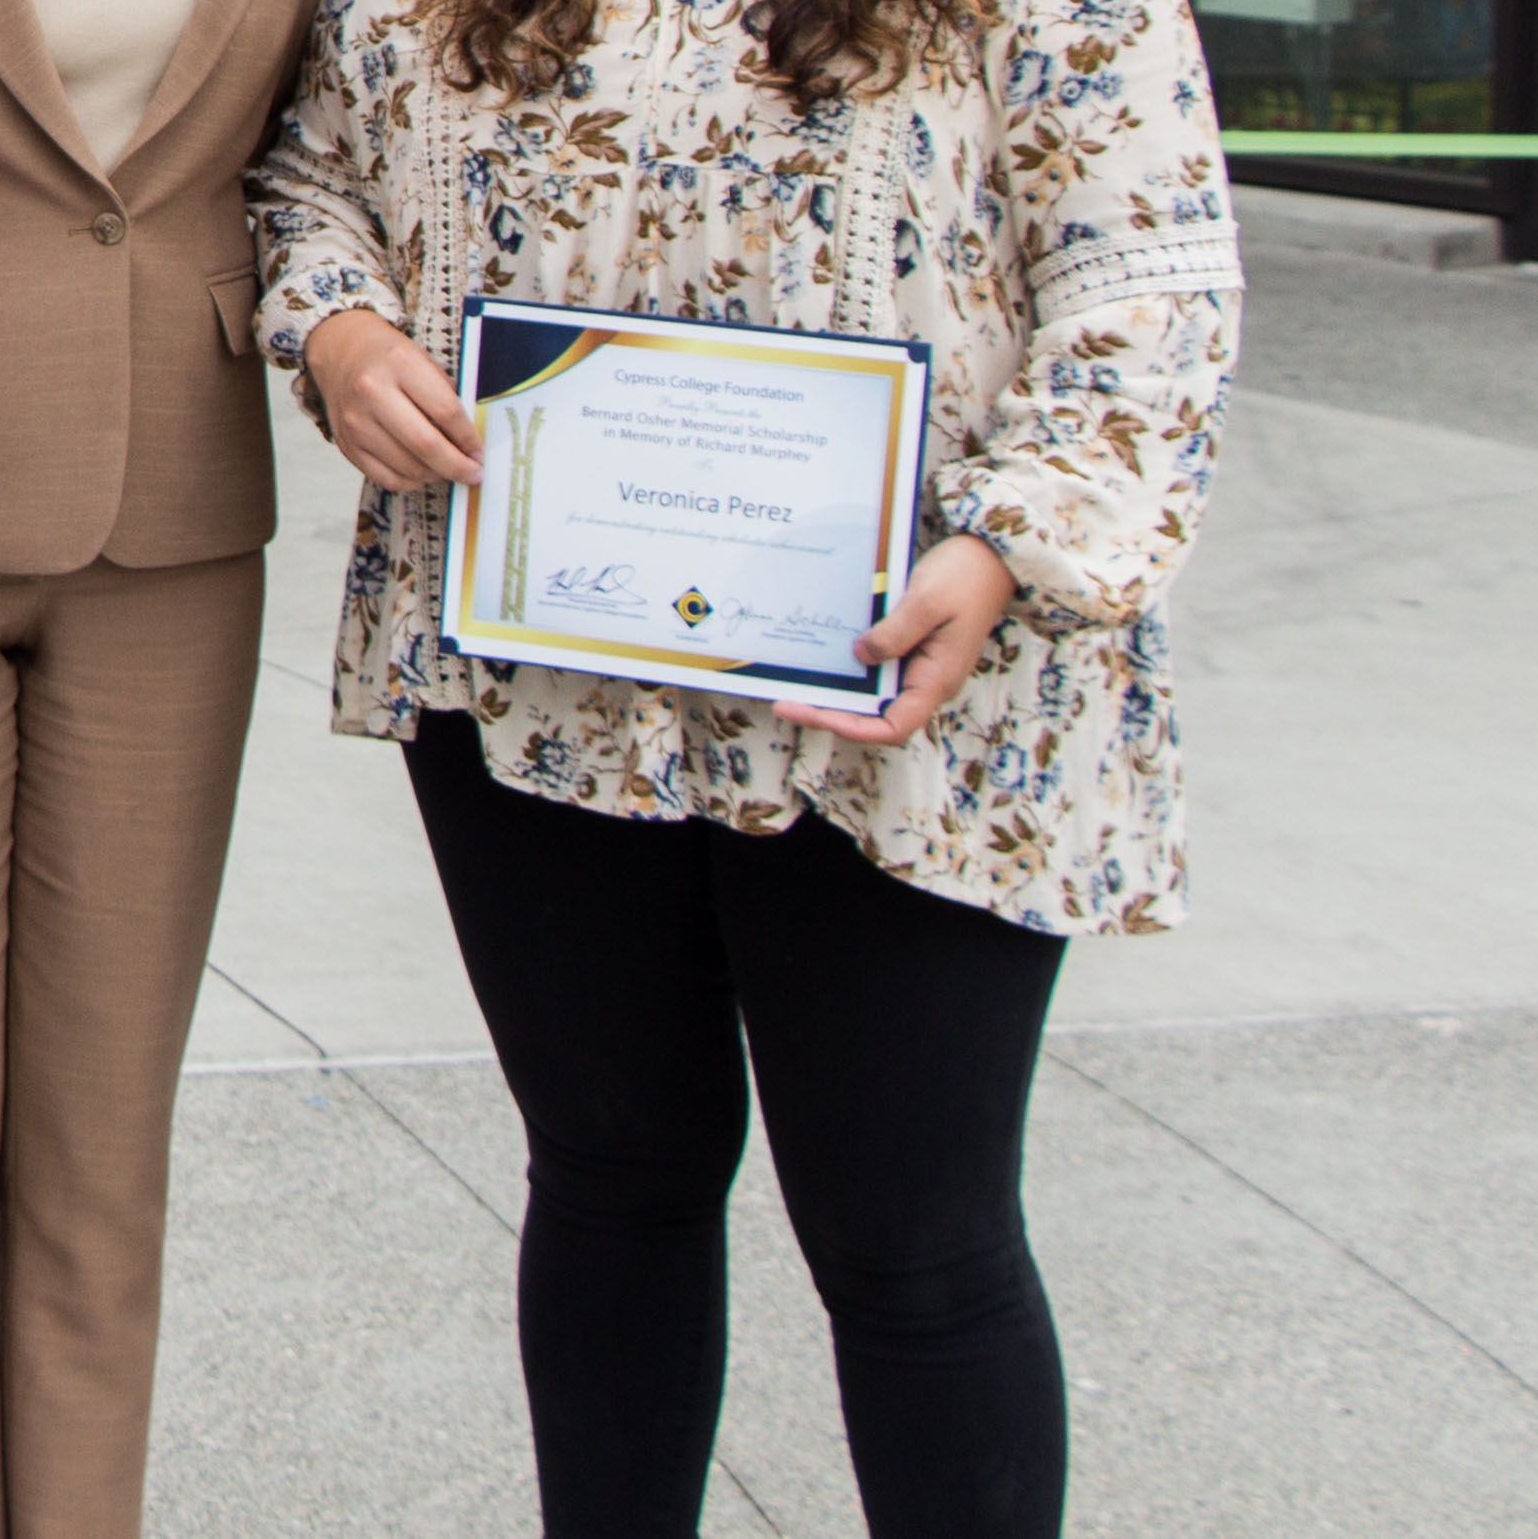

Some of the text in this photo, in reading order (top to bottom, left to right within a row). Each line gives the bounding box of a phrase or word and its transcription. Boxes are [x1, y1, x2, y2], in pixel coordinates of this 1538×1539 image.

[613, 368, 804, 402] Cypress College Foundation
[580, 405, 828, 447] Bernard Osher Memorial Scholarship
[602, 427, 811, 463] in Memory of Richard Murphey
[618, 481, 792, 524] Veronica Perez
